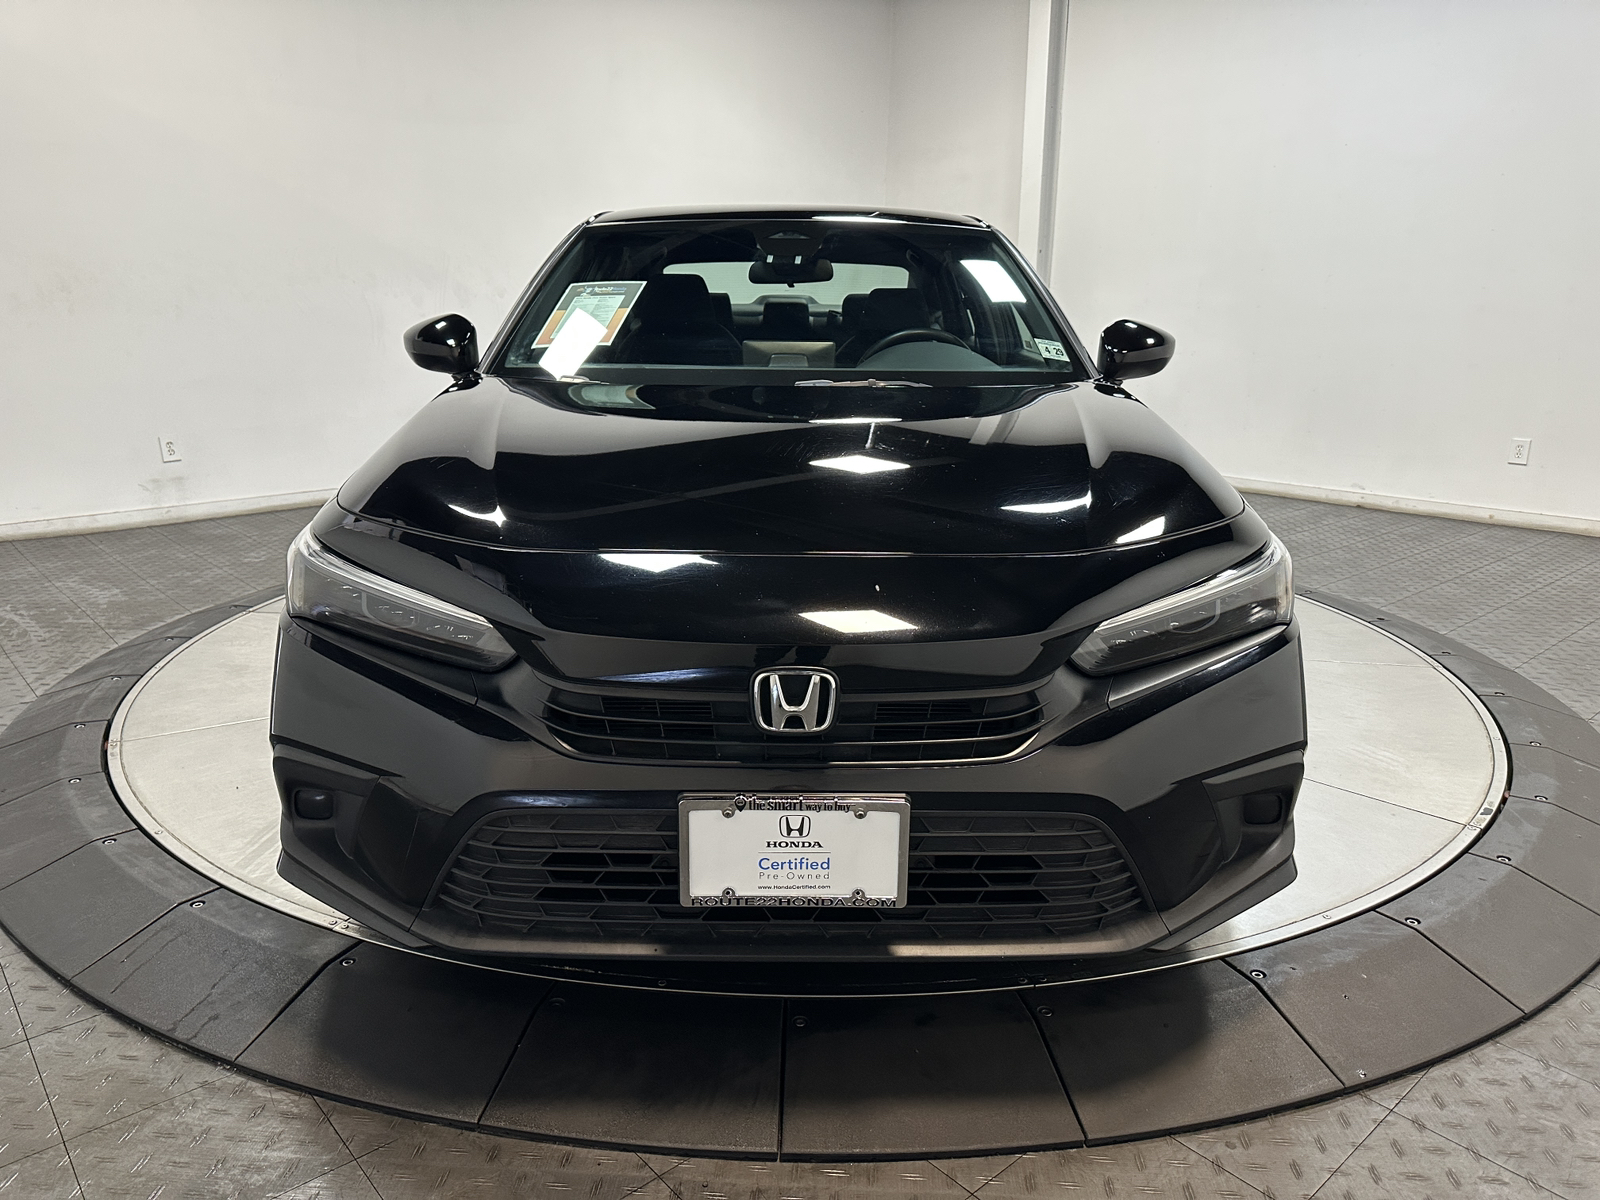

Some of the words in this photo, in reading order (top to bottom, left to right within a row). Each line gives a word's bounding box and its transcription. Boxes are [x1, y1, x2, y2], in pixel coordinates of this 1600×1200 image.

[748, 796, 766, 811] the
[767, 795, 804, 811] smart
[805, 802, 821, 813] way
[823, 799, 833, 811] to
[758, 857, 830, 870] Certified
[759, 872, 830, 880] Pre-Owned
[691, 897, 897, 908] ROUTE22HONDA.COM
